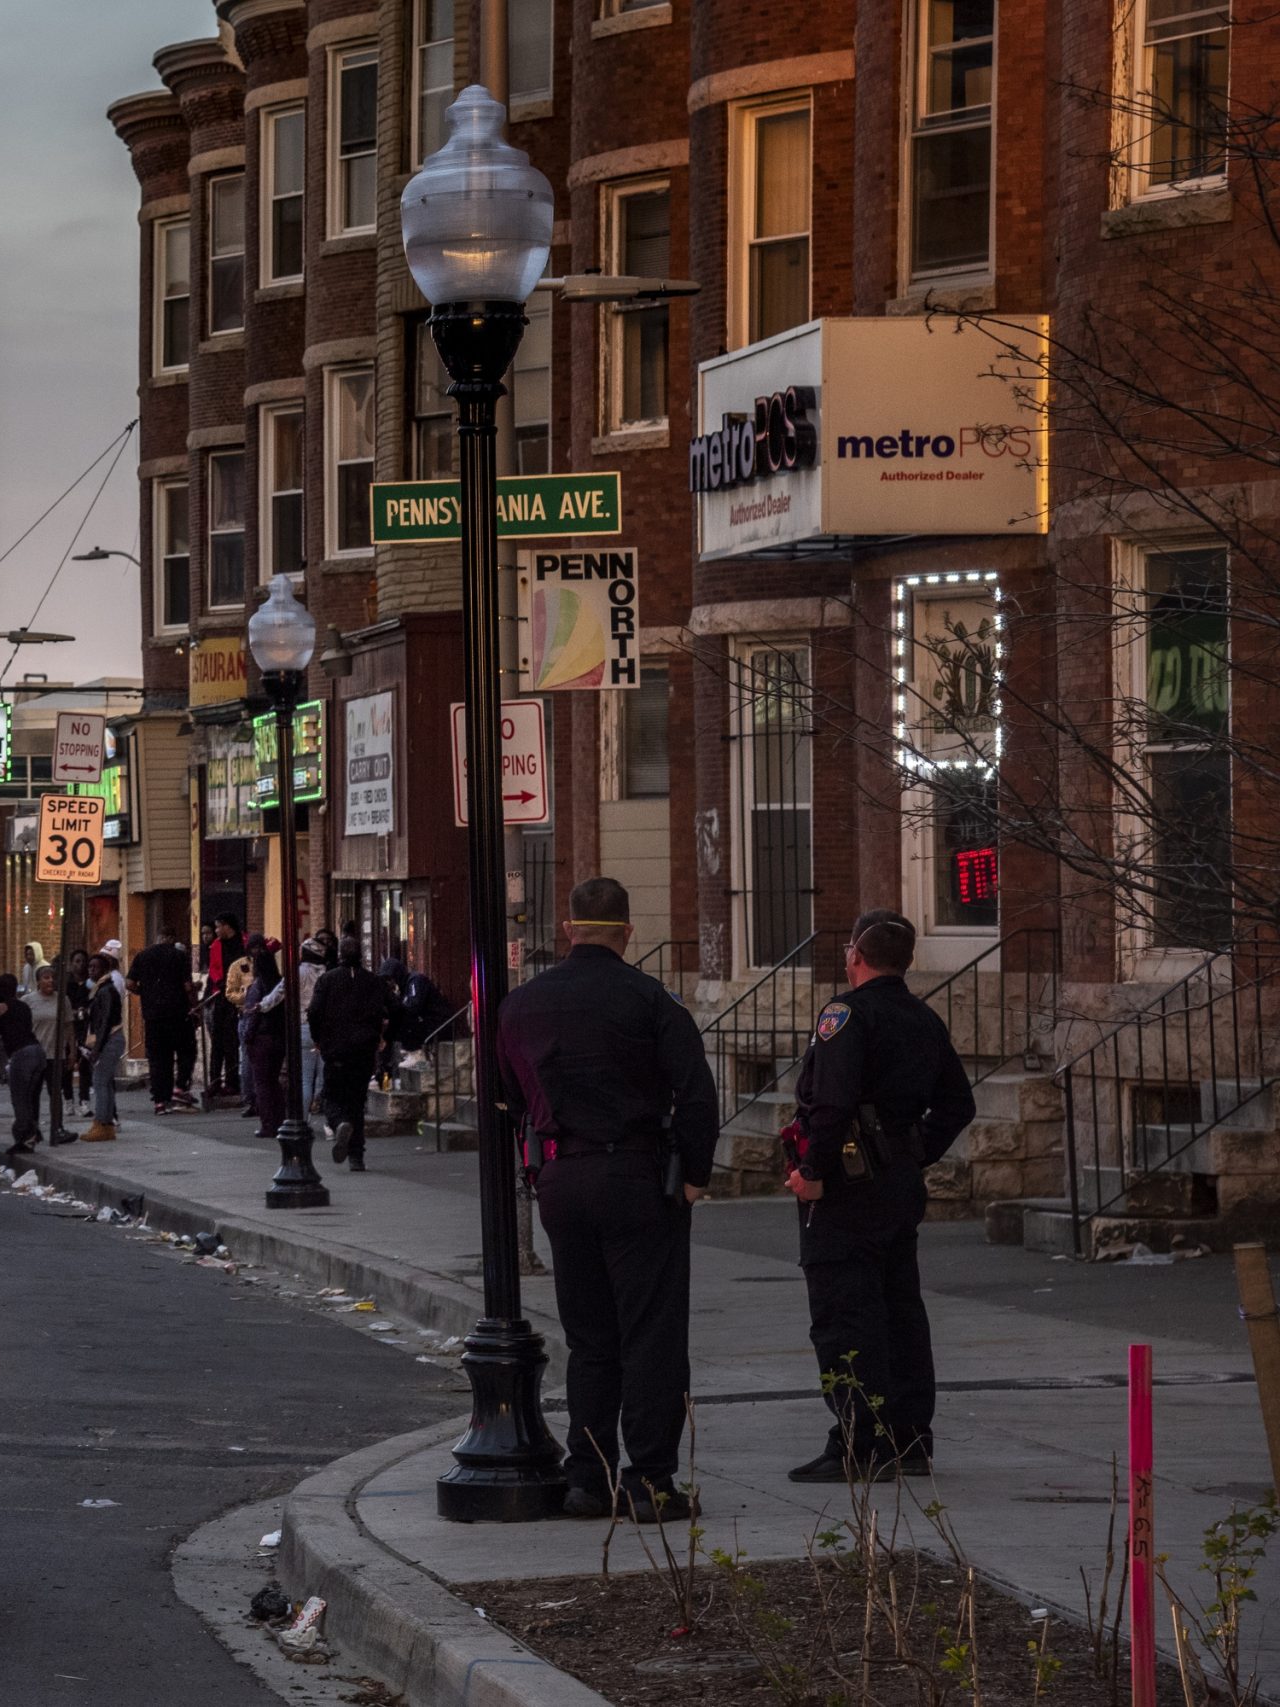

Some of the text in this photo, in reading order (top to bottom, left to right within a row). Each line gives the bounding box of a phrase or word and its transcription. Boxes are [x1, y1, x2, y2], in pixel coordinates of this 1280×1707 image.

[689, 386, 800, 491] metroPCS
[837, 426, 1032, 459] metroPCS
[879, 470, 985, 482] Authorized Dealer
[386, 490, 611, 528] PENNSYANIA AVE.
[730, 493, 792, 527] Authorized Dealer
[536, 552, 634, 581] PENN
[71, 722, 90, 736] NO
[59, 742, 100, 757] STOPPING
[350, 757, 389, 781] CARRY OUT
[47, 799, 99, 815] SPEED
[51, 818, 91, 832] LIMIT
[45, 834, 95, 869] 30
[42, 868, 95, 878] CHECKED BY RADAR
